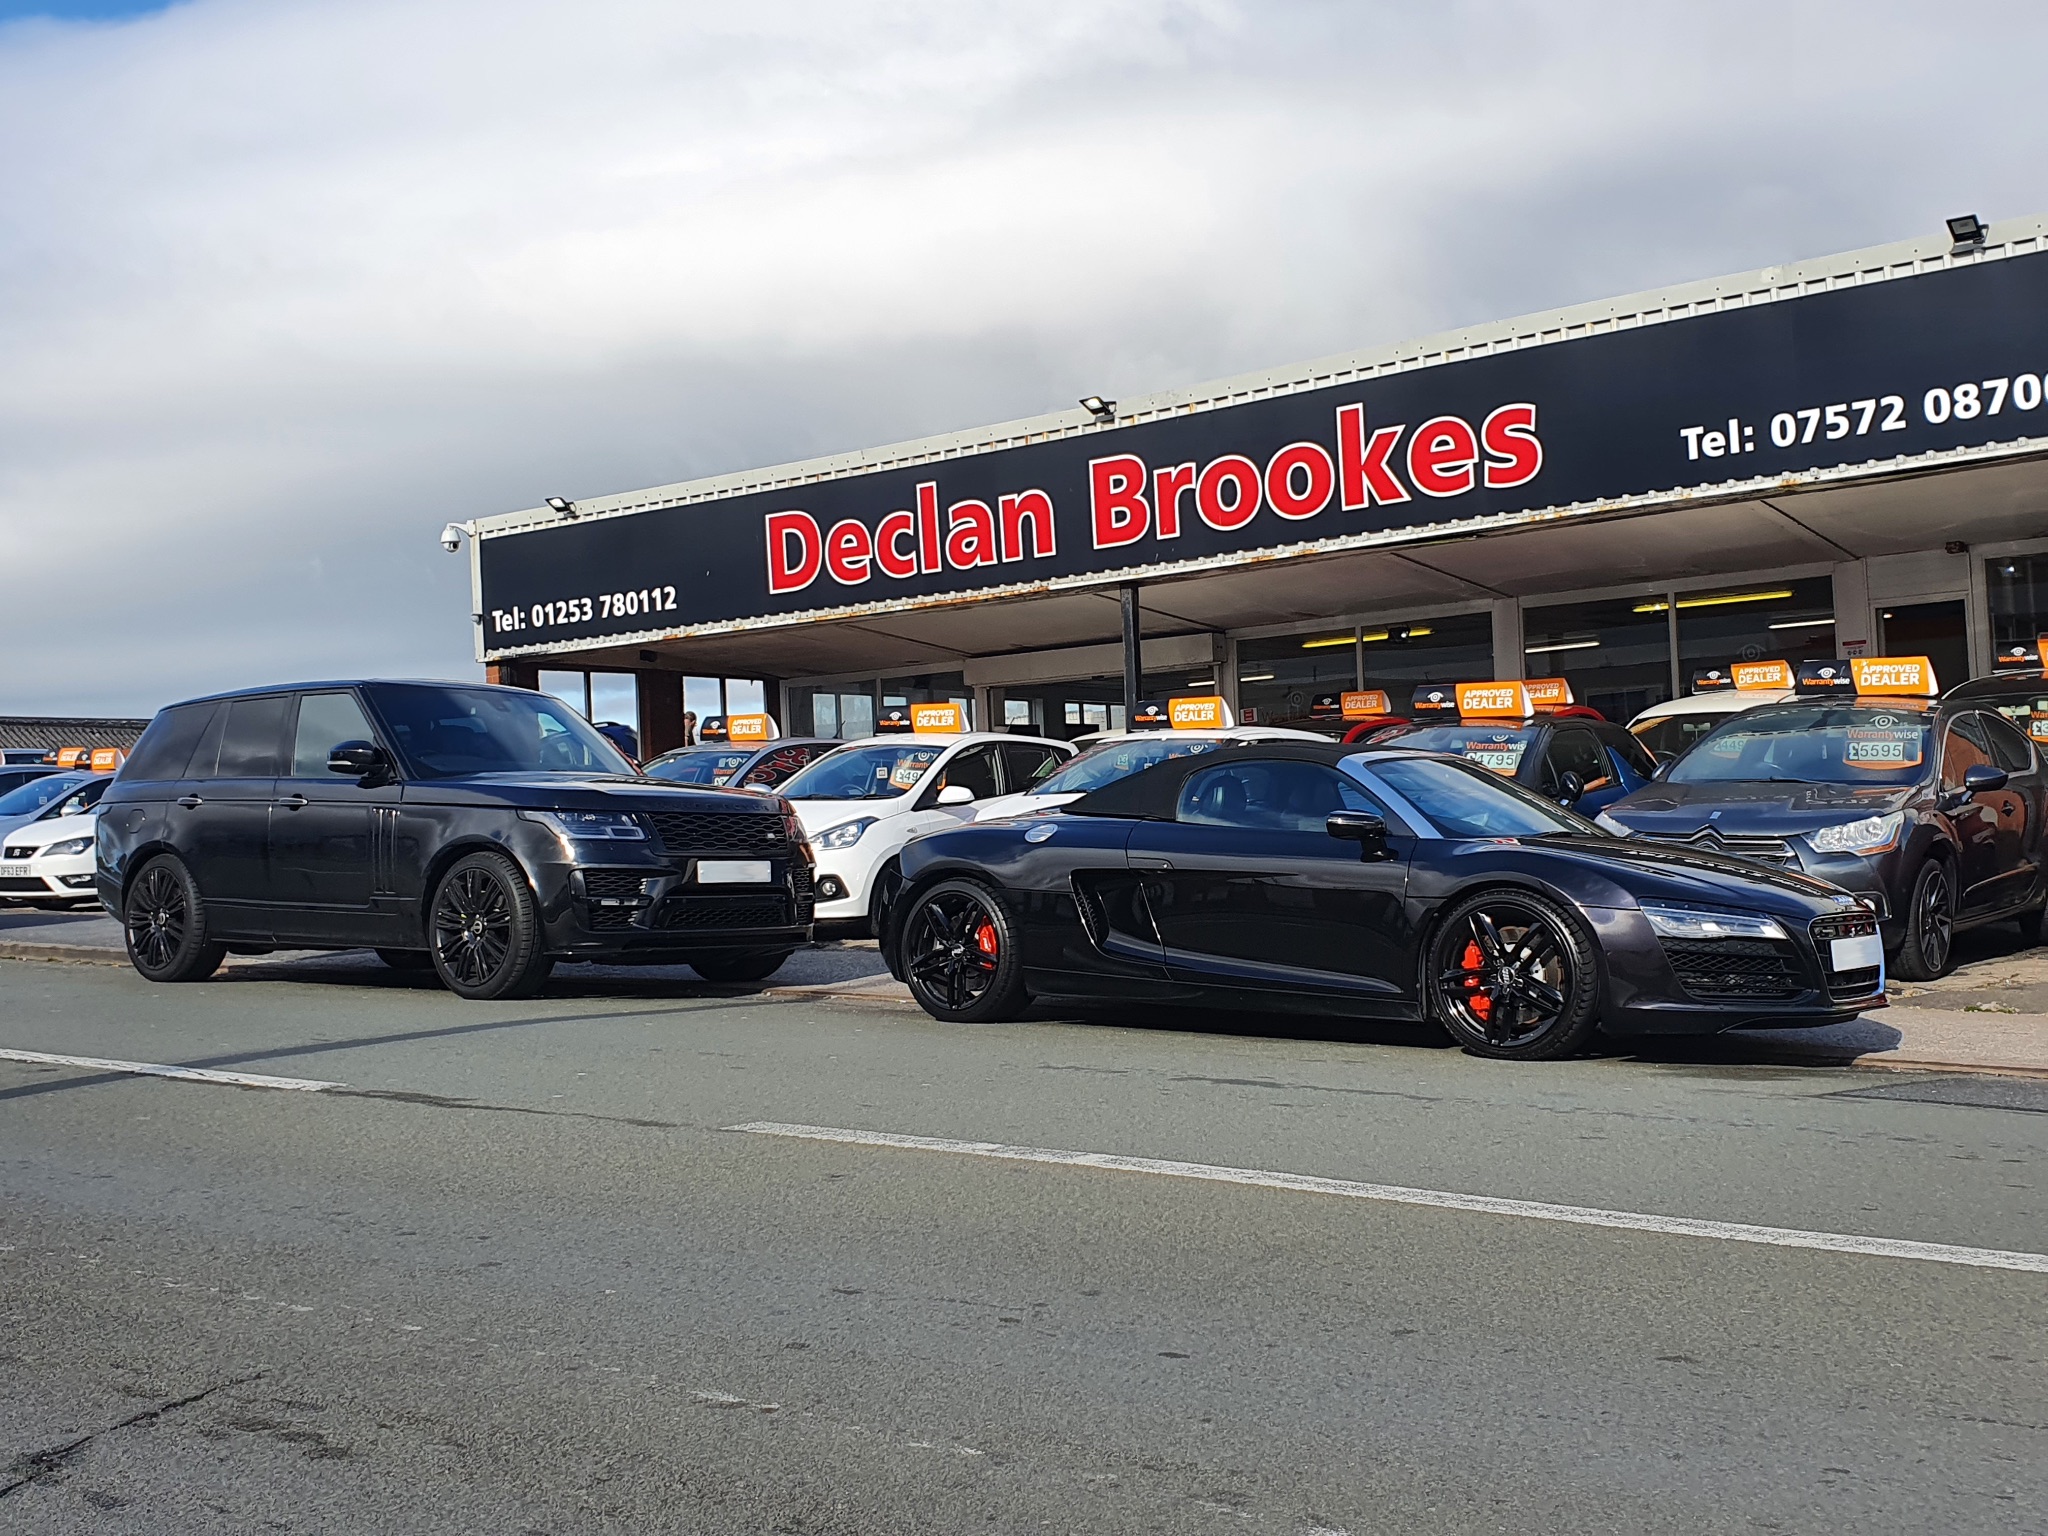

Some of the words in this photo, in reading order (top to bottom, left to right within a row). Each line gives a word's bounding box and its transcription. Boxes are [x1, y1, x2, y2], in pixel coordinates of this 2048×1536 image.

[1679, 418, 1755, 460] Tel:
[1770, 395, 1907, 448] 07572
[1922, 372, 2048, 425] 0870
[764, 480, 1057, 595] Declan
[1088, 401, 1543, 550] Brookes
[492, 606, 526, 633] Tel:
[531, 597, 593, 628] 01253
[599, 585, 677, 619] 780112
[1861, 664, 1920, 674] APPROVED
[1738, 673, 1781, 684] DEALER
[1802, 677, 1850, 686] Warrantywise
[1860, 672, 1920, 686] DEALER
[1463, 688, 1514, 698] APPROVED
[1529, 688, 1559, 698] EALER
[1175, 703, 1215, 711] APPROVED
[1345, 700, 1377, 709] DEALER
[1415, 701, 1455, 710] Warrantywise
[1463, 697, 1513, 709] DEALER
[1174, 710, 1214, 721] DEALER
[916, 716, 954, 726] DEALER
[732, 725, 761, 734] DEALER
[1847, 729, 1918, 741] Warrantywise
[1848, 743, 1902, 759] £5595
